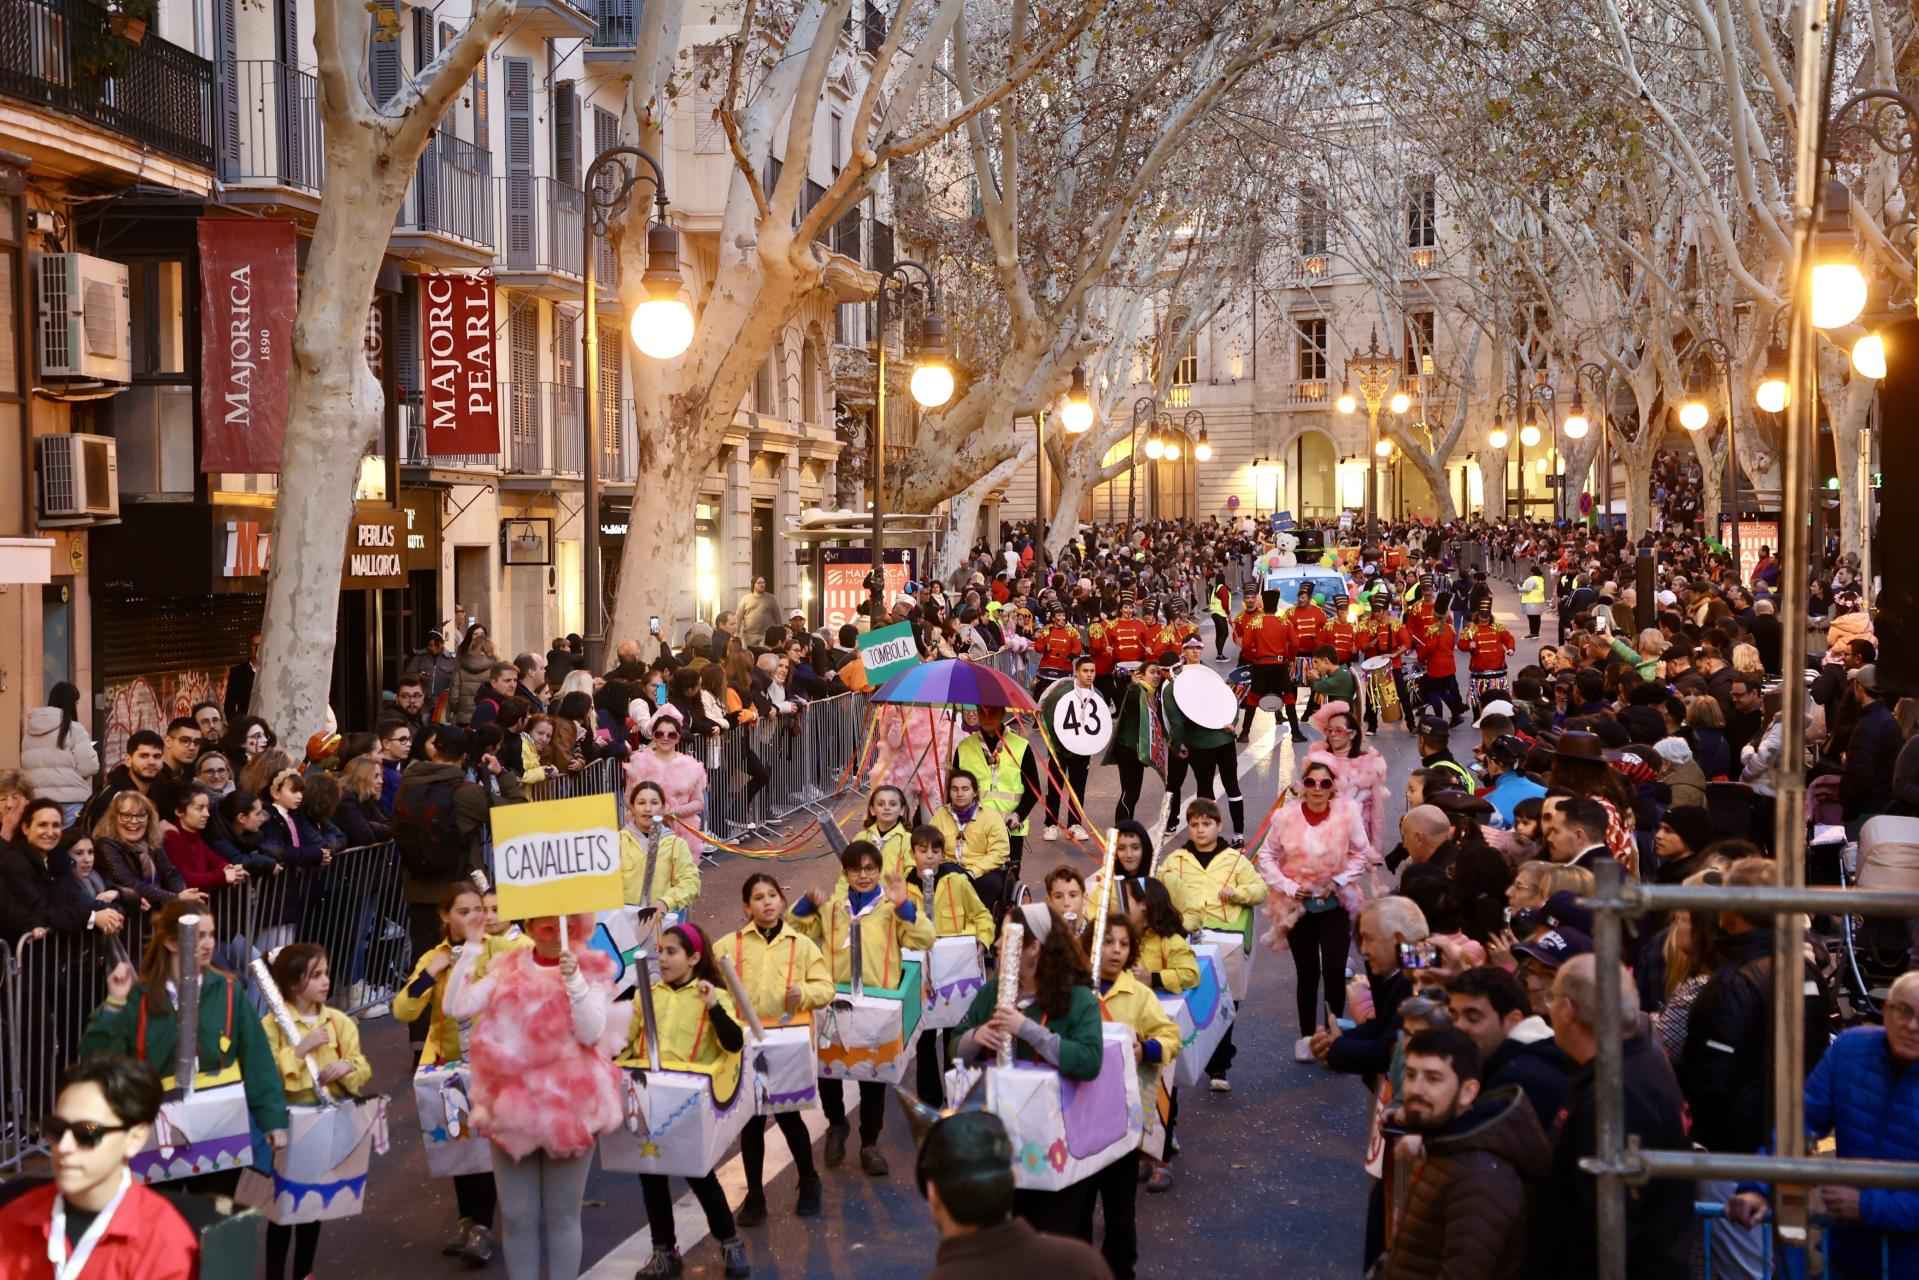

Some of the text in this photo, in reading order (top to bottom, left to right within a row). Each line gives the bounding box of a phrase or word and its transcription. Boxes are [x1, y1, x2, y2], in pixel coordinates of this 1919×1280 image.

[225, 264, 256, 427] MAJORICA
[260, 329, 271, 361] 1890
[428, 271, 462, 430] MAJORC
[358, 524, 395, 547] PERLAS
[351, 553, 401, 577] MALLORCA
[845, 568, 905, 578] MALRCA
[870, 639, 911, 665] TOMBOLA
[1062, 697, 1101, 736] 43
[505, 834, 611, 881] CAVALLETS
